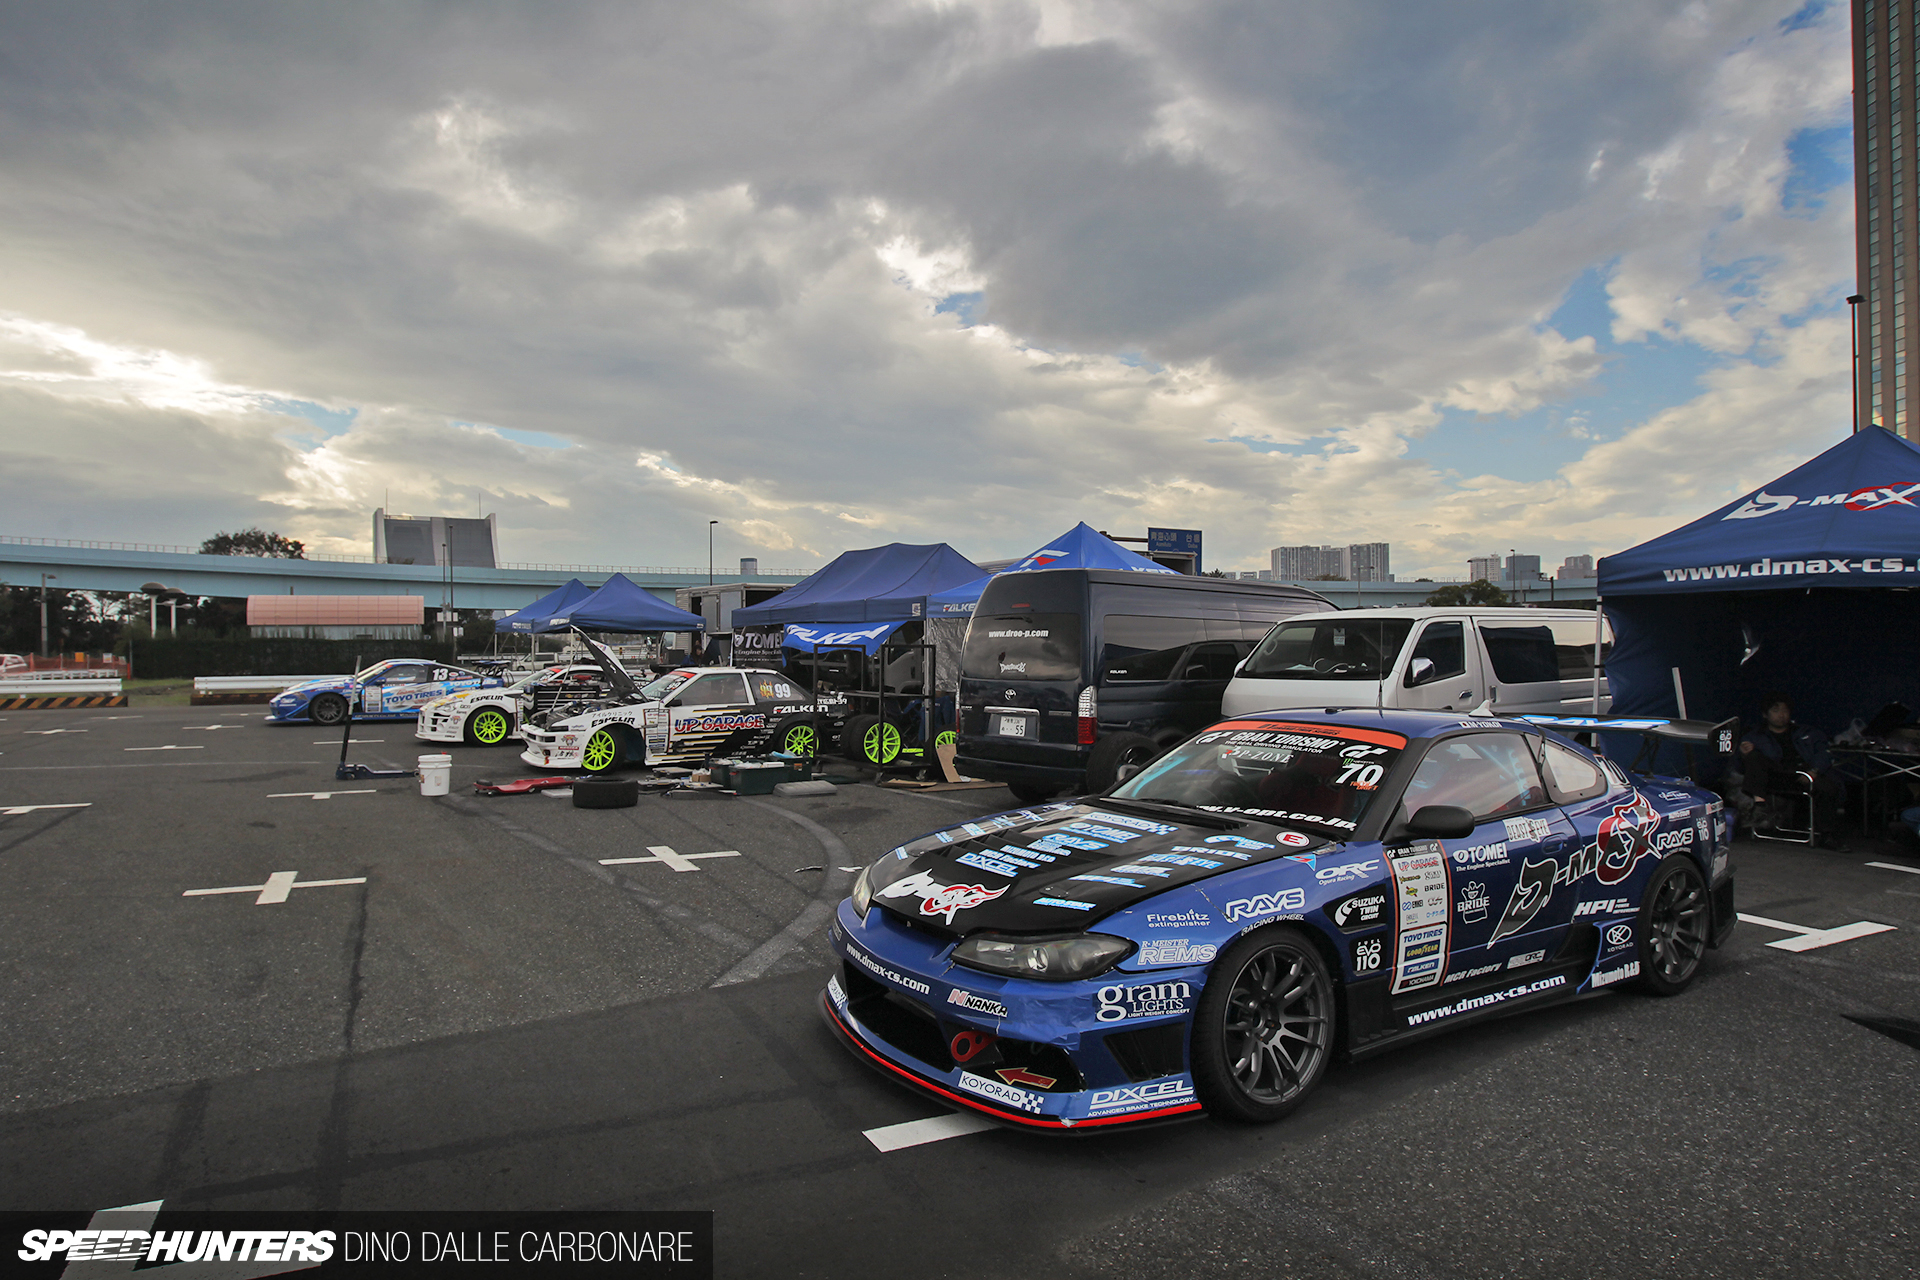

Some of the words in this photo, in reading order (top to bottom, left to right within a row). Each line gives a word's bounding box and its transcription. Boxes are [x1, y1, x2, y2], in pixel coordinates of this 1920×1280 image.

[1663, 558, 1920, 582] www.dmax-cs.
[433, 668, 449, 681] 13
[774, 683, 791, 698] 99
[386, 693, 413, 704] TOYO
[591, 716, 636, 728] ESPELIR
[675, 718, 700, 734] UP
[701, 713, 766, 732] GARAGE
[1015, 724, 1024, 735] 55
[1230, 732, 1275, 744] GRAN
[1282, 745, 1323, 754] SIMULATOR
[1335, 764, 1384, 787] 70
[1042, 833, 1109, 850] RAYS
[1283, 833, 1303, 844] E
[1657, 827, 1694, 851] RAYS
[1171, 846, 1252, 861] BRIDE
[1468, 842, 1508, 863] TOMEI
[957, 852, 1019, 877] DIXCEL
[1315, 859, 1380, 879] ORC
[1398, 861, 1409, 872] UP
[1410, 857, 1439, 870] GARAGE
[1467, 863, 1485, 871] Engine
[1486, 859, 1510, 868] Specialist
[1318, 878, 1336, 886] Ogura
[1424, 883, 1445, 892] BRIDE
[1225, 887, 1305, 923] RAYS
[1352, 895, 1385, 908] SUZUKA
[1457, 896, 1490, 912] BRIDE
[1574, 899, 1616, 916] HPI
[1147, 911, 1210, 922] Fireblitz
[1360, 905, 1379, 915] TWIN
[1360, 913, 1380, 921] CIRCUIT
[1149, 920, 1210, 928] extinguisher
[1241, 915, 1275, 937] RACING
[1276, 913, 1304, 921] WHEEL
[1404, 933, 1422, 943] TOYO
[1423, 928, 1443, 939] TIRES
[1137, 944, 1217, 965] REMS
[1407, 944, 1438, 957] GOODYEAR
[1607, 942, 1634, 953] KOYORAD
[846, 943, 930, 995] www.dmax-cs.com
[1356, 953, 1381, 971] 110
[1408, 962, 1435, 973] FALKEN
[1466, 962, 1502, 978] Factory
[1591, 967, 1625, 989] Mizumoto
[1097, 981, 1191, 1022] gram
[1132, 999, 1184, 1012] LIGHTS
[1407, 974, 1565, 1026] www.dmax-cs.com
[961, 1075, 1021, 1103] KOYORAD
[1091, 1080, 1194, 1106] DIXCEL
[1088, 1106, 1125, 1117] ADVANCED
[1126, 1103, 1149, 1111] BRAKE
[1150, 1097, 1194, 1109] TECHNOLOGY
